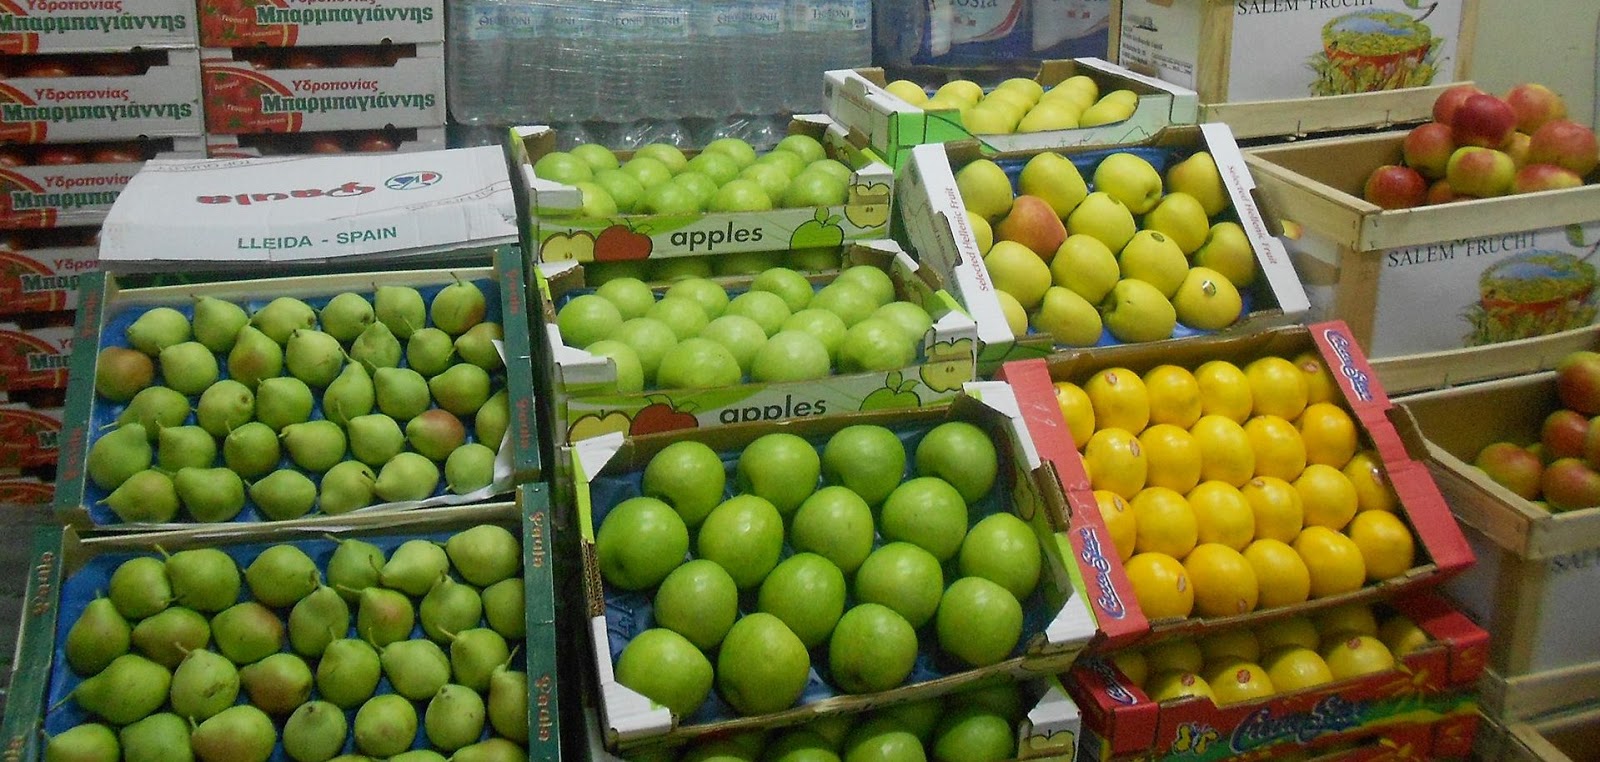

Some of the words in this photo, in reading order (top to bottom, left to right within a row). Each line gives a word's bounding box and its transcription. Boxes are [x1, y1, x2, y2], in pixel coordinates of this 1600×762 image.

[257, 4, 434, 26] Μπαρμπαγιάννης
[1237, 0, 1299, 15] SALEM
[34, 87, 129, 102] Υδροπονίας
[292, 79, 378, 93] Υδροπονίας
[3, 101, 192, 123] Μπαρμπαγιάννης
[262, 92, 435, 114] Μπαρμπαγιάννης
[44, 173, 133, 189] Υδροπονία
[945, 187, 959, 210] Fruit
[1227, 165, 1247, 201] Selected
[1244, 201, 1264, 239] Hellenic
[1262, 242, 1278, 265] Fruit
[237, 234, 313, 252] LLEIDA
[336, 226, 398, 244] SPAIN
[671, 221, 763, 251] apples
[954, 210, 973, 251] Hellenic
[1388, 243, 1455, 268] SALEM
[966, 251, 989, 292] Selected
[719, 394, 827, 425] apples
